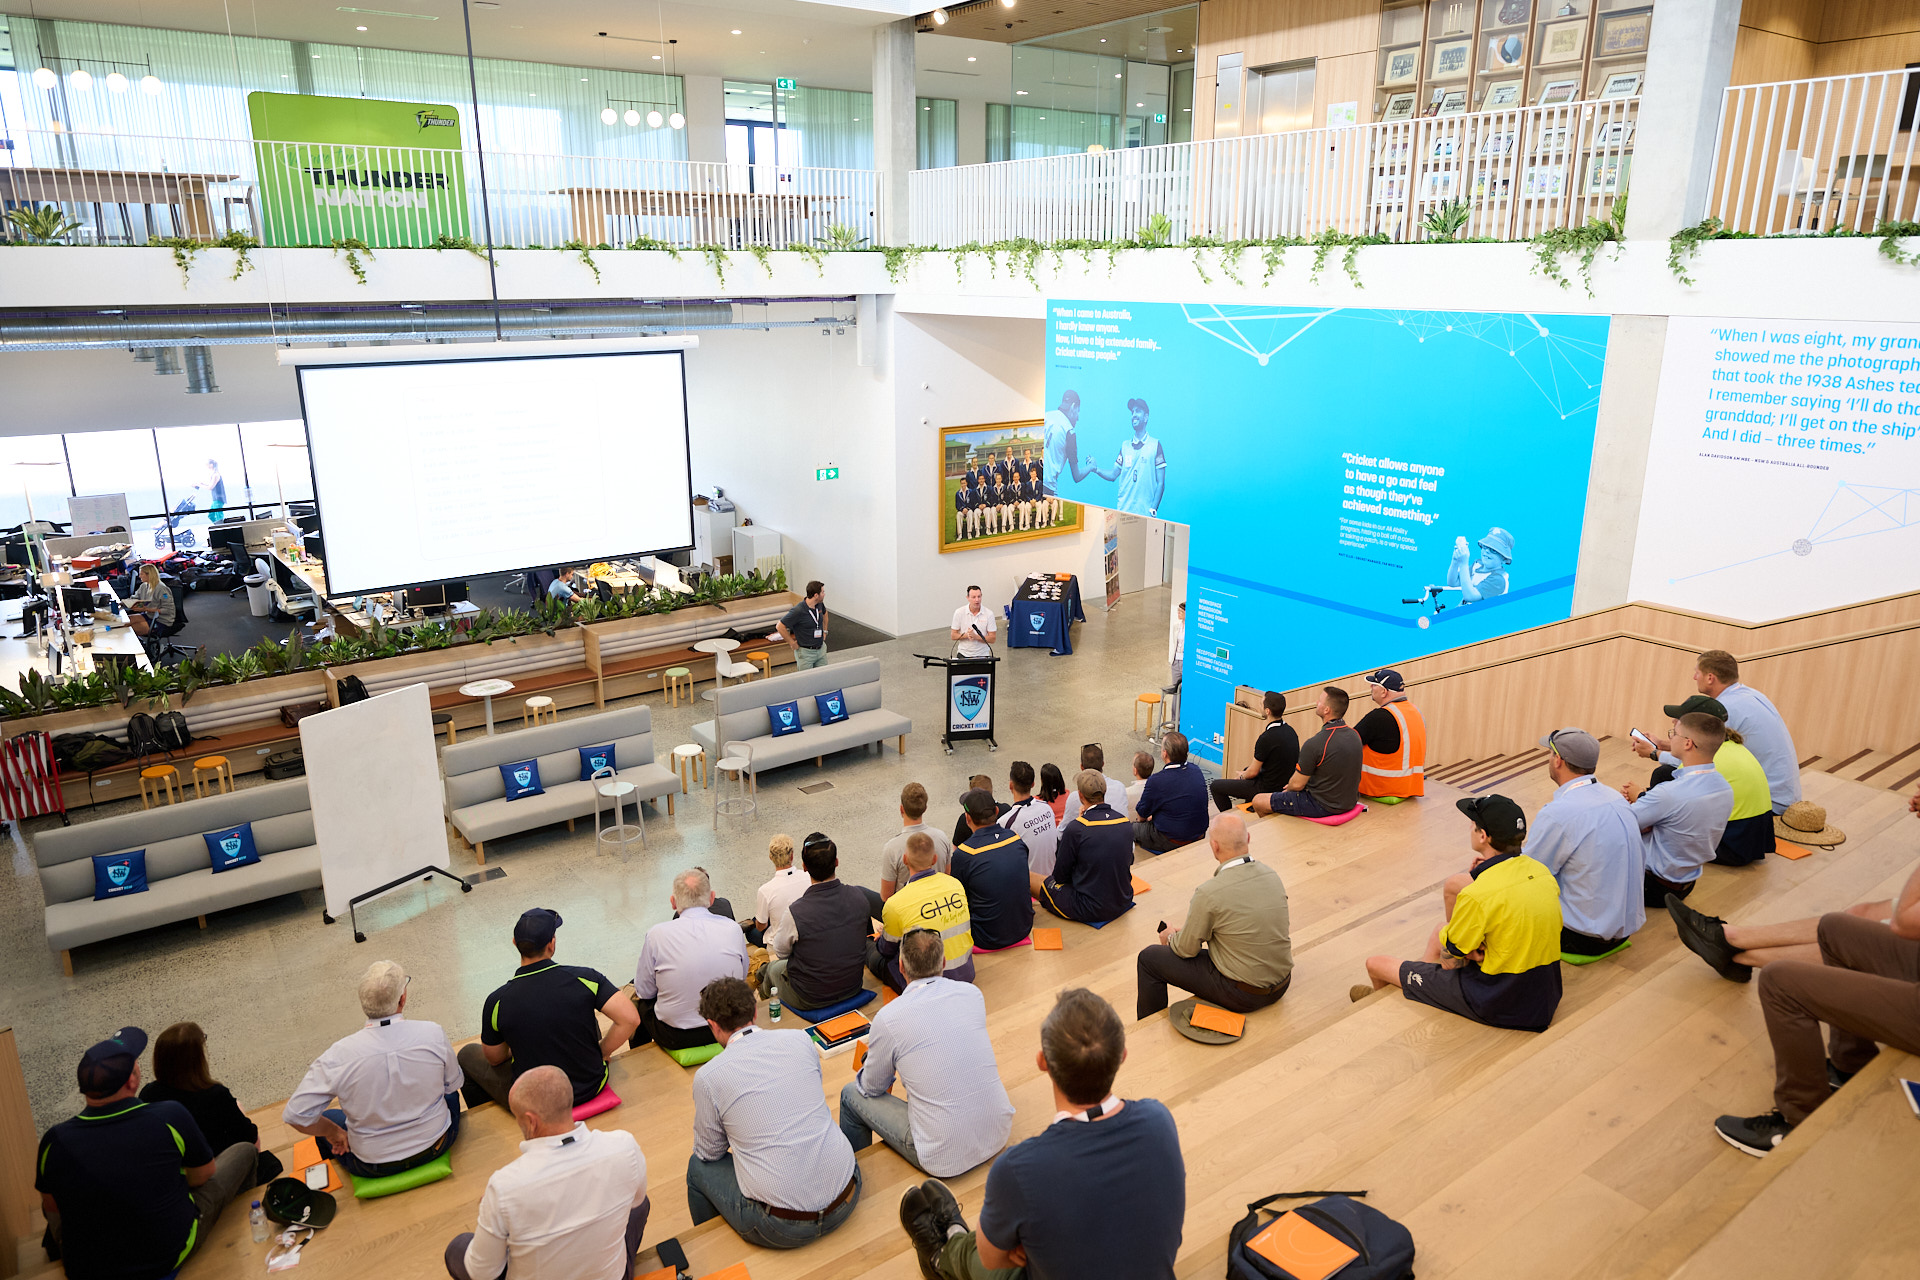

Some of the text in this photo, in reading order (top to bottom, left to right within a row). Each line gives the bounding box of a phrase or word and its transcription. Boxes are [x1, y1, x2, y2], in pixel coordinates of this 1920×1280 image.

[304, 168, 450, 190] THUNDER
[314, 188, 428, 209] NATION
[1077, 310, 1094, 318] came
[1095, 310, 1101, 318] to
[1102, 309, 1132, 321] Australia,
[1059, 320, 1078, 333] hardly
[1078, 322, 1095, 332] knew
[1096, 324, 1120, 334] anyone.
[1056, 334, 1070, 344] Now,
[1074, 335, 1089, 344] have
[1095, 336, 1104, 348] big
[1105, 337, 1135, 348] extended
[1710, 328, 1920, 351] "When I was eight, my gran
[1055, 347, 1076, 357] Cricket
[1076, 348, 1095, 358] unites
[1715, 348, 1920, 374] showed me the photograph
[1712, 368, 1740, 382] that
[1744, 371, 1774, 384] took
[1780, 373, 1803, 386] the
[1807, 374, 1842, 388] 1938
[1845, 376, 1895, 393] Ashes
[1709, 388, 1713, 400] I
[1716, 390, 1787, 406] remember
[1791, 395, 1841, 413] saying
[1846, 397, 1869, 412] 'I'll
[1873, 400, 1893, 414] do
[1705, 409, 1776, 427] granddad;
[1780, 414, 1797, 427] I'll
[1800, 417, 1825, 431] get
[1829, 419, 1848, 431] on
[1852, 420, 1877, 434] the
[1702, 427, 1728, 441] And
[1732, 429, 1736, 441] I
[1740, 430, 1761, 444] did
[1777, 434, 1816, 449] three
[1820, 437, 1876, 455] times."
[1342, 452, 1445, 477] "Cricket allows anyone
[1345, 469, 1437, 492] to have a go and feel
[1344, 485, 1423, 506] as though they've
[1342, 499, 1439, 526] achieved something."
[1024, 811, 1052, 829] GROUND
[1034, 822, 1051, 836] STAFF
[921, 893, 962, 919] GHG
